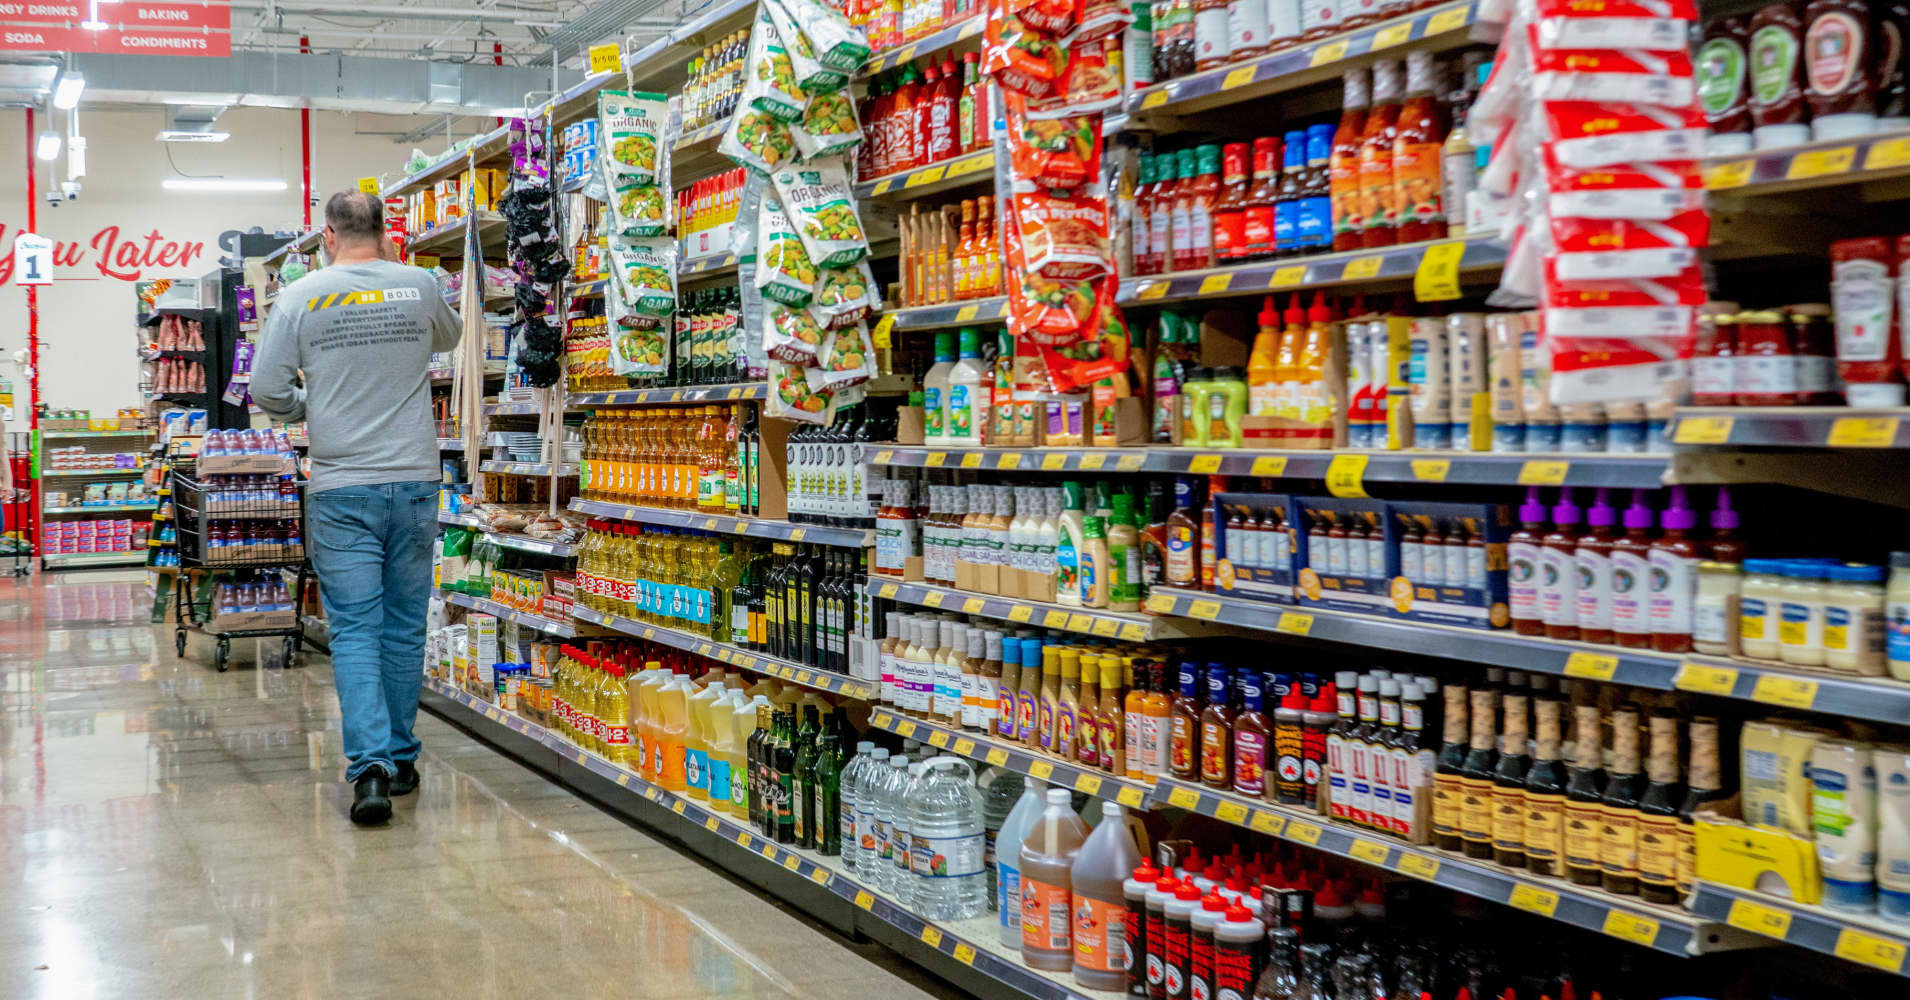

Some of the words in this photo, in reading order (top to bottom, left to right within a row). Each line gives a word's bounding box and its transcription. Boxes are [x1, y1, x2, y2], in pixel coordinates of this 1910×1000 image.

[28, 4, 79, 17] DRINKS
[138, 8, 190, 20] BAKING
[5, 32, 45, 45] SODA
[121, 36, 207, 49] CONDIMENTS
[791, 183, 844, 203] ORGANIC
[91, 226, 204, 281] Later
[26, 255, 41, 278] 1
[387, 290, 417, 299] BOLD
[370, 307, 398, 315] SAFETY
